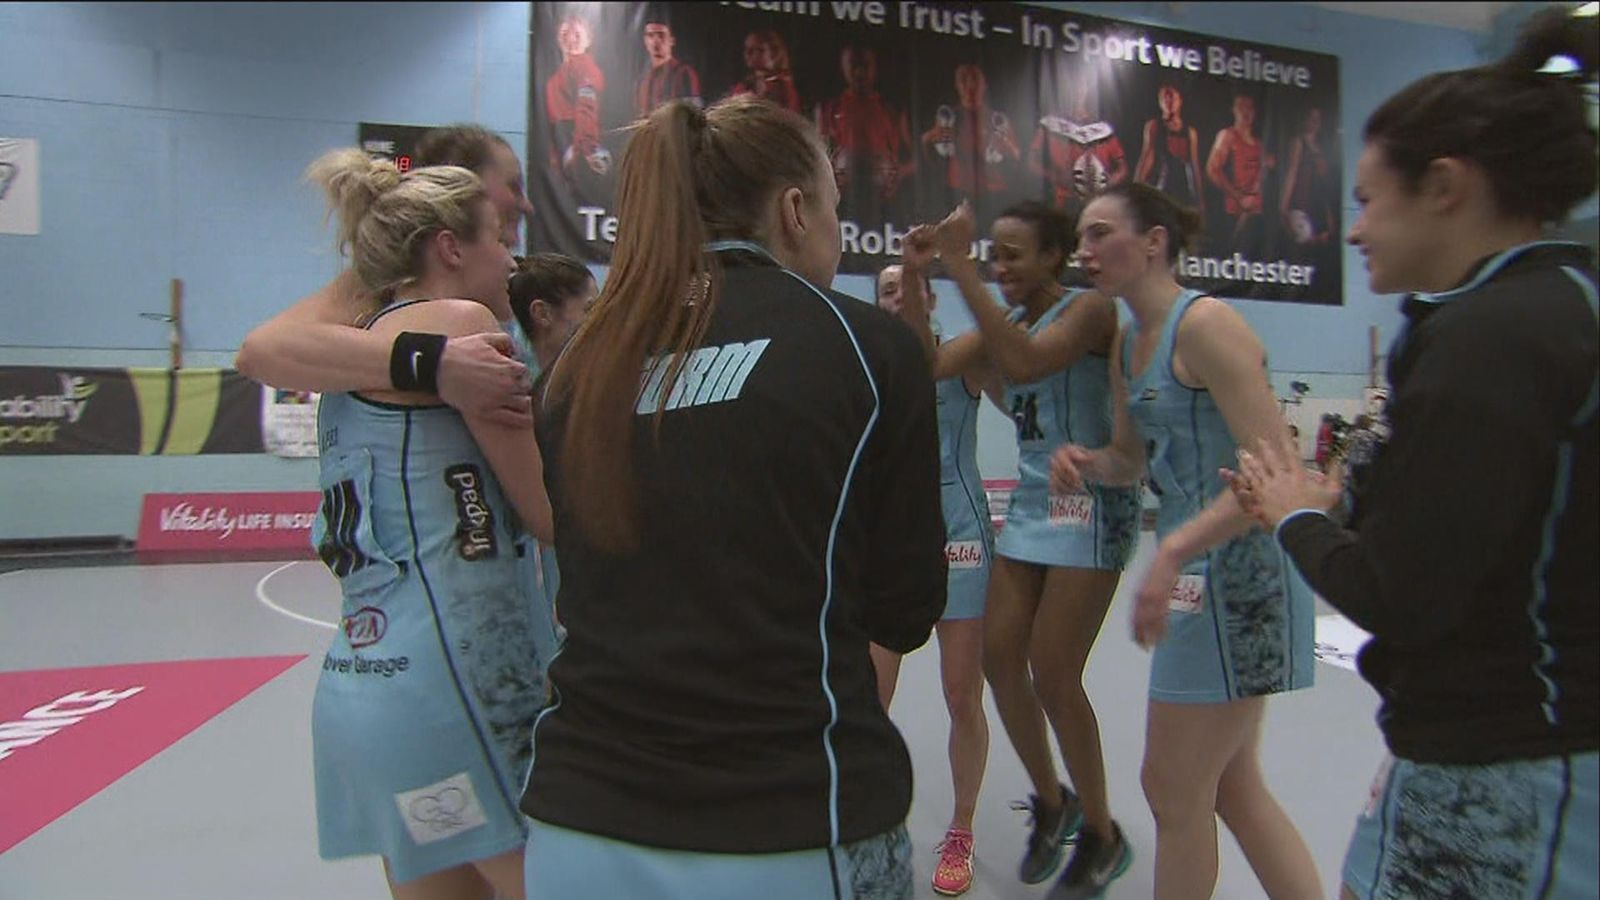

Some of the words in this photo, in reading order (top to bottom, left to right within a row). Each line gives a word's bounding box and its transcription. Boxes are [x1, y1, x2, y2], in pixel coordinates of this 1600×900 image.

[831, 1, 886, 24] we
[900, 1, 985, 39] Trust
[1021, 15, 1052, 48] In
[1062, 21, 1151, 64] Sport
[1155, 43, 1200, 71] we
[1208, 45, 1311, 88] Believe
[1178, 252, 1314, 286] anchester
[635, 338, 771, 415] ORM
[160, 501, 236, 540] Vitality
[238, 513, 272, 529] LIFE
[946, 544, 982, 567] tality
